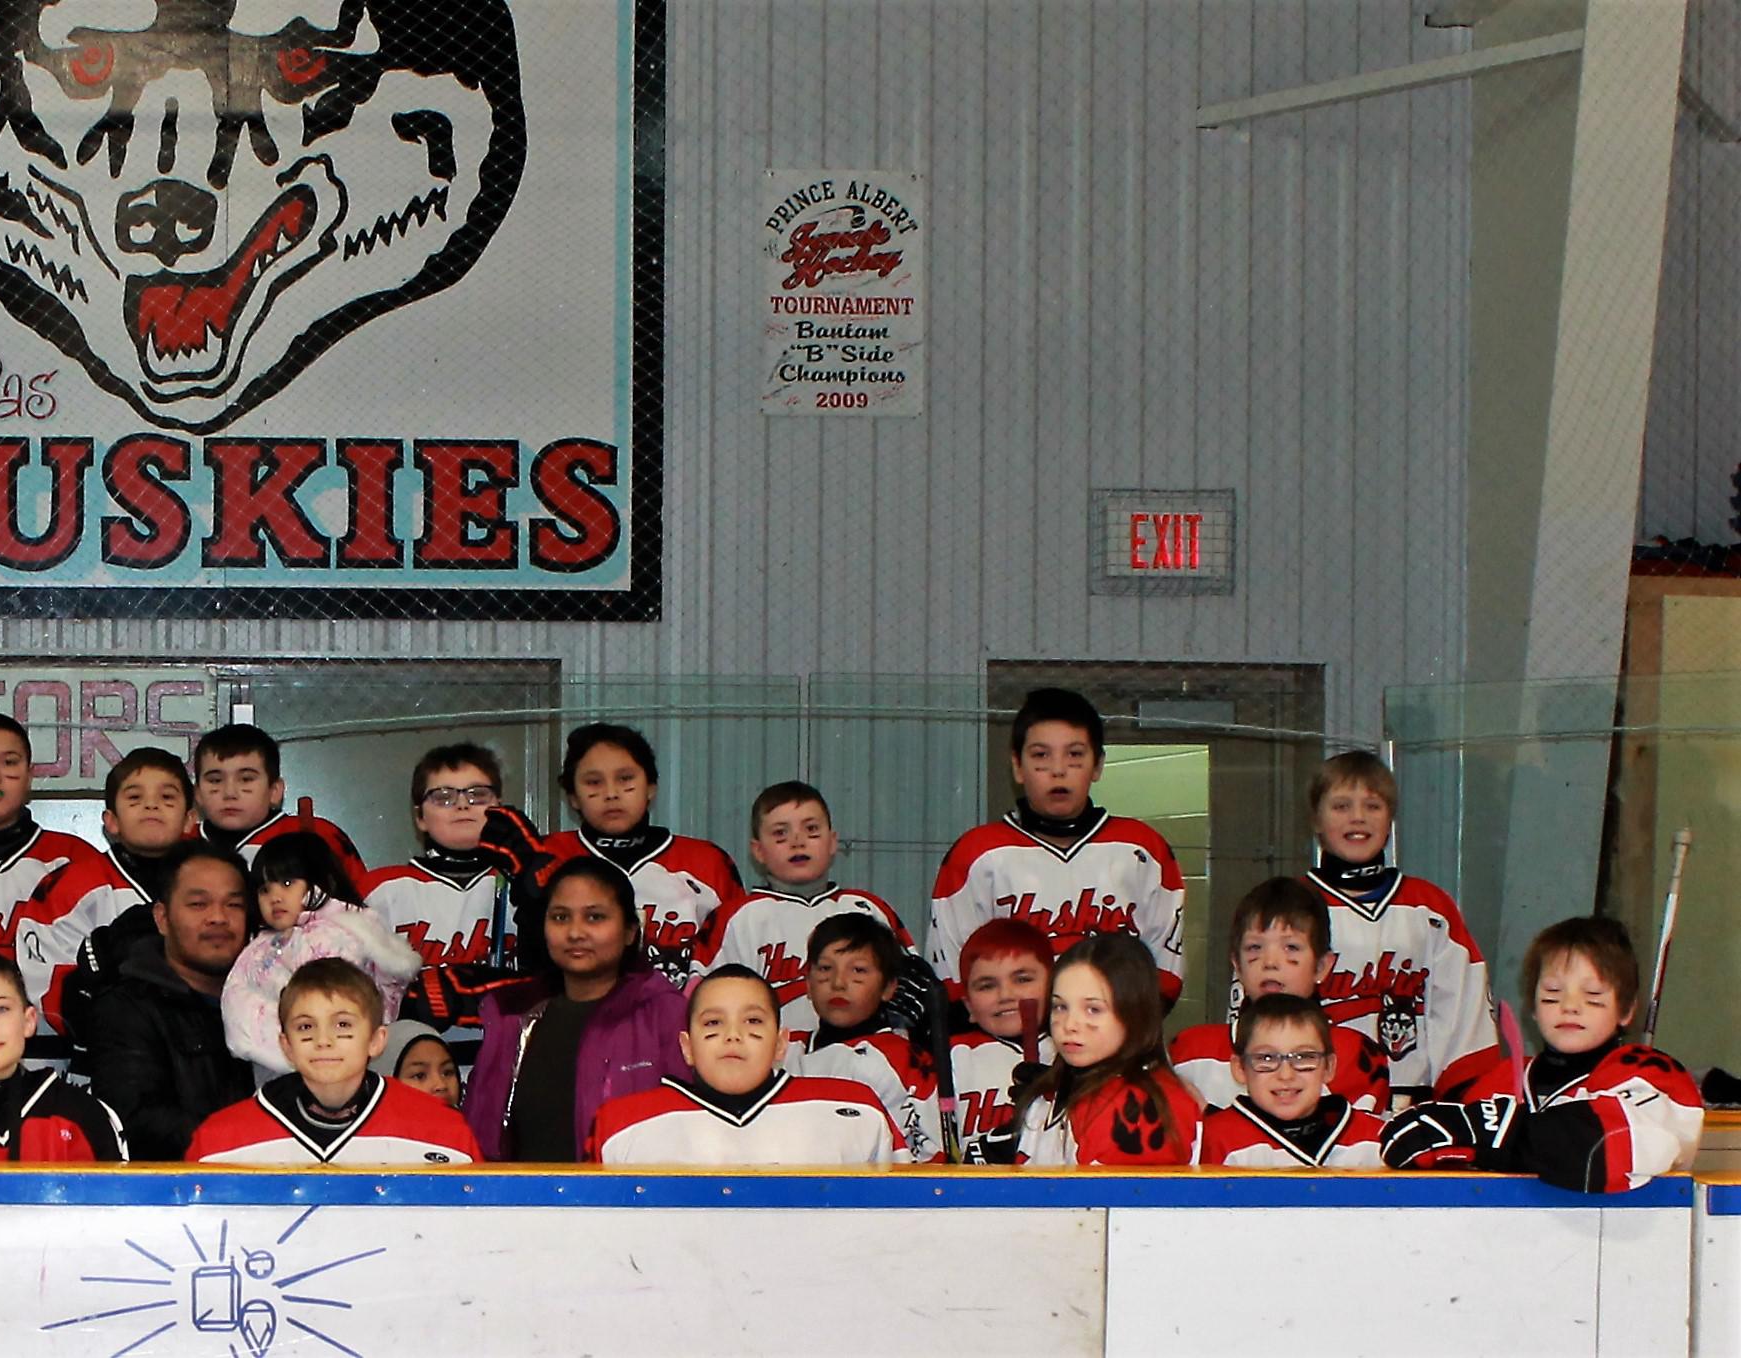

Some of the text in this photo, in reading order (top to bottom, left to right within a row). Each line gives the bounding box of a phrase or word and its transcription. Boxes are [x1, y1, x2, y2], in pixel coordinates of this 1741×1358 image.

[765, 180, 918, 235] PRINCE ALBERT
[770, 296, 914, 315] TOURNAMENT
[795, 320, 890, 340] Bantam
[841, 346, 895, 363] Side
[779, 364, 905, 386] Champions
[816, 392, 868, 408] 2009
[1130, 513, 1203, 569] EXIT
